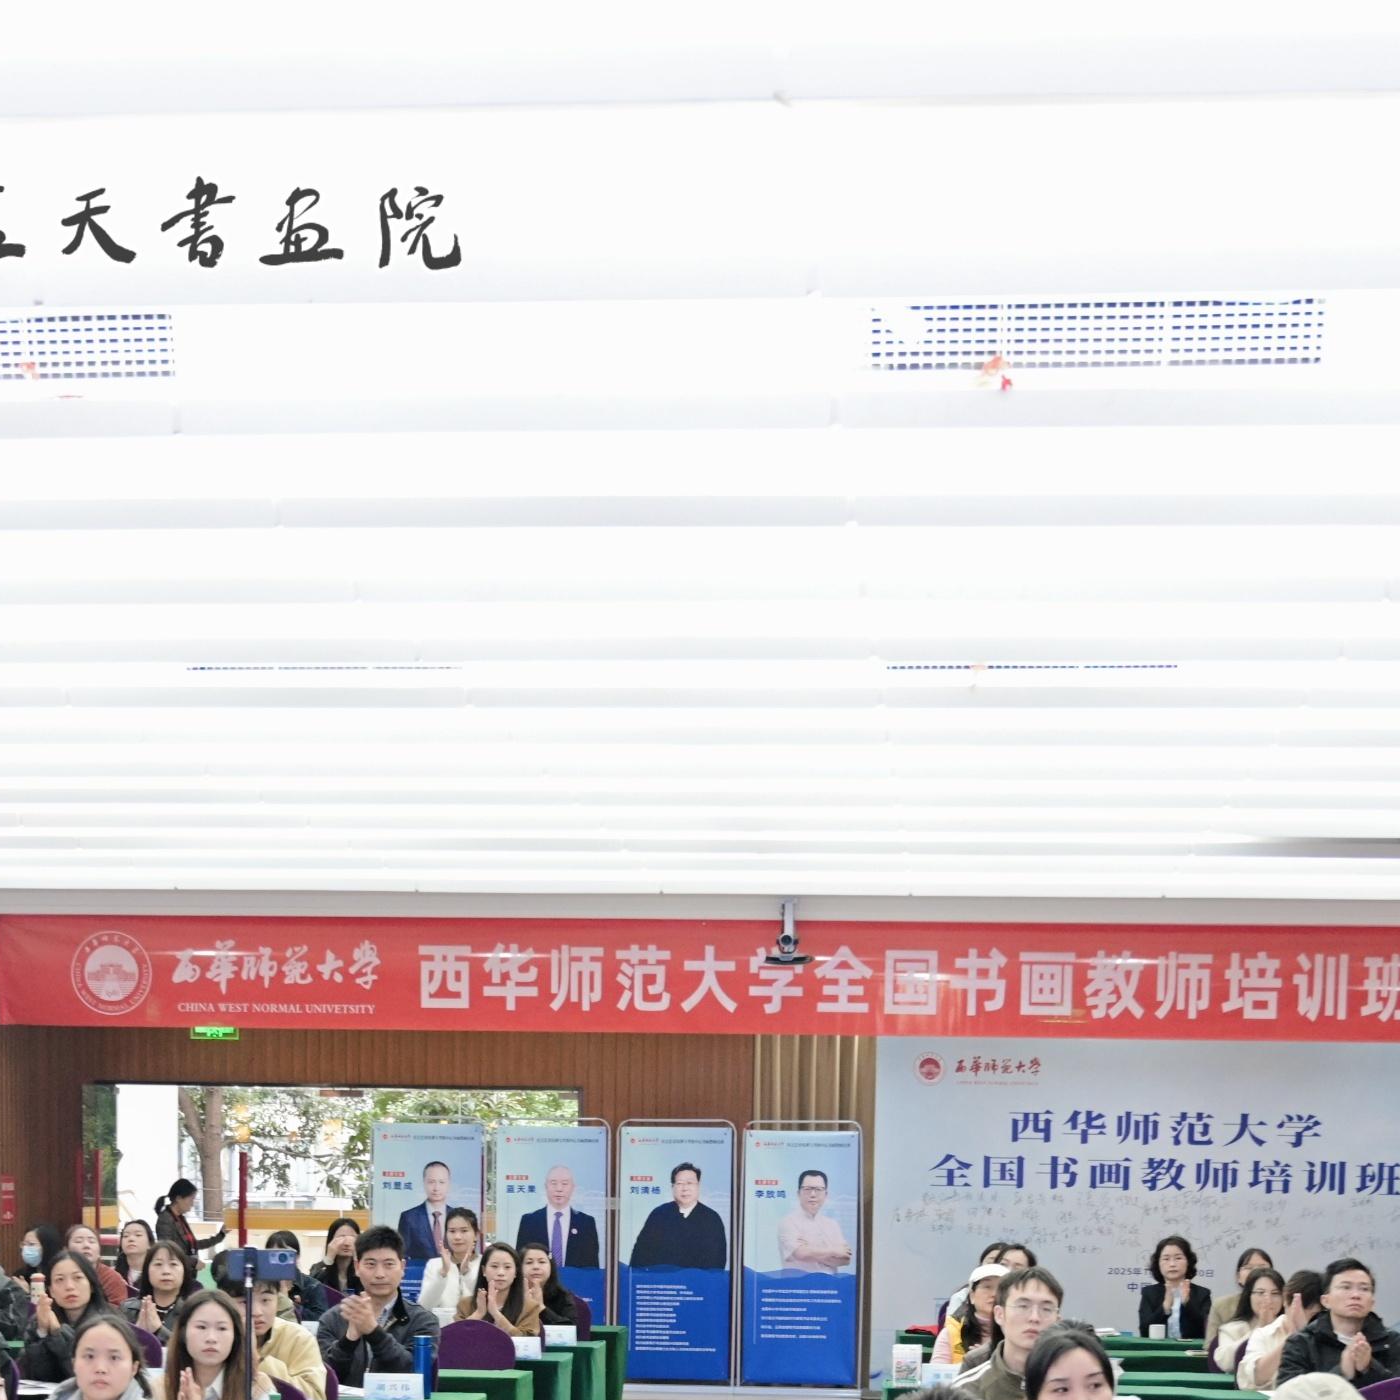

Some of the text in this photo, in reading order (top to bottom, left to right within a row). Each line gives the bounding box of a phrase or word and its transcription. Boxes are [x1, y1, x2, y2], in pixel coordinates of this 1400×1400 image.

[177, 1002, 215, 1014] CHINA
[218, 1003, 249, 1014] WEST
[252, 1003, 303, 1014] NORMAL
[1008, 1109, 1323, 1149] 西华师范大学
